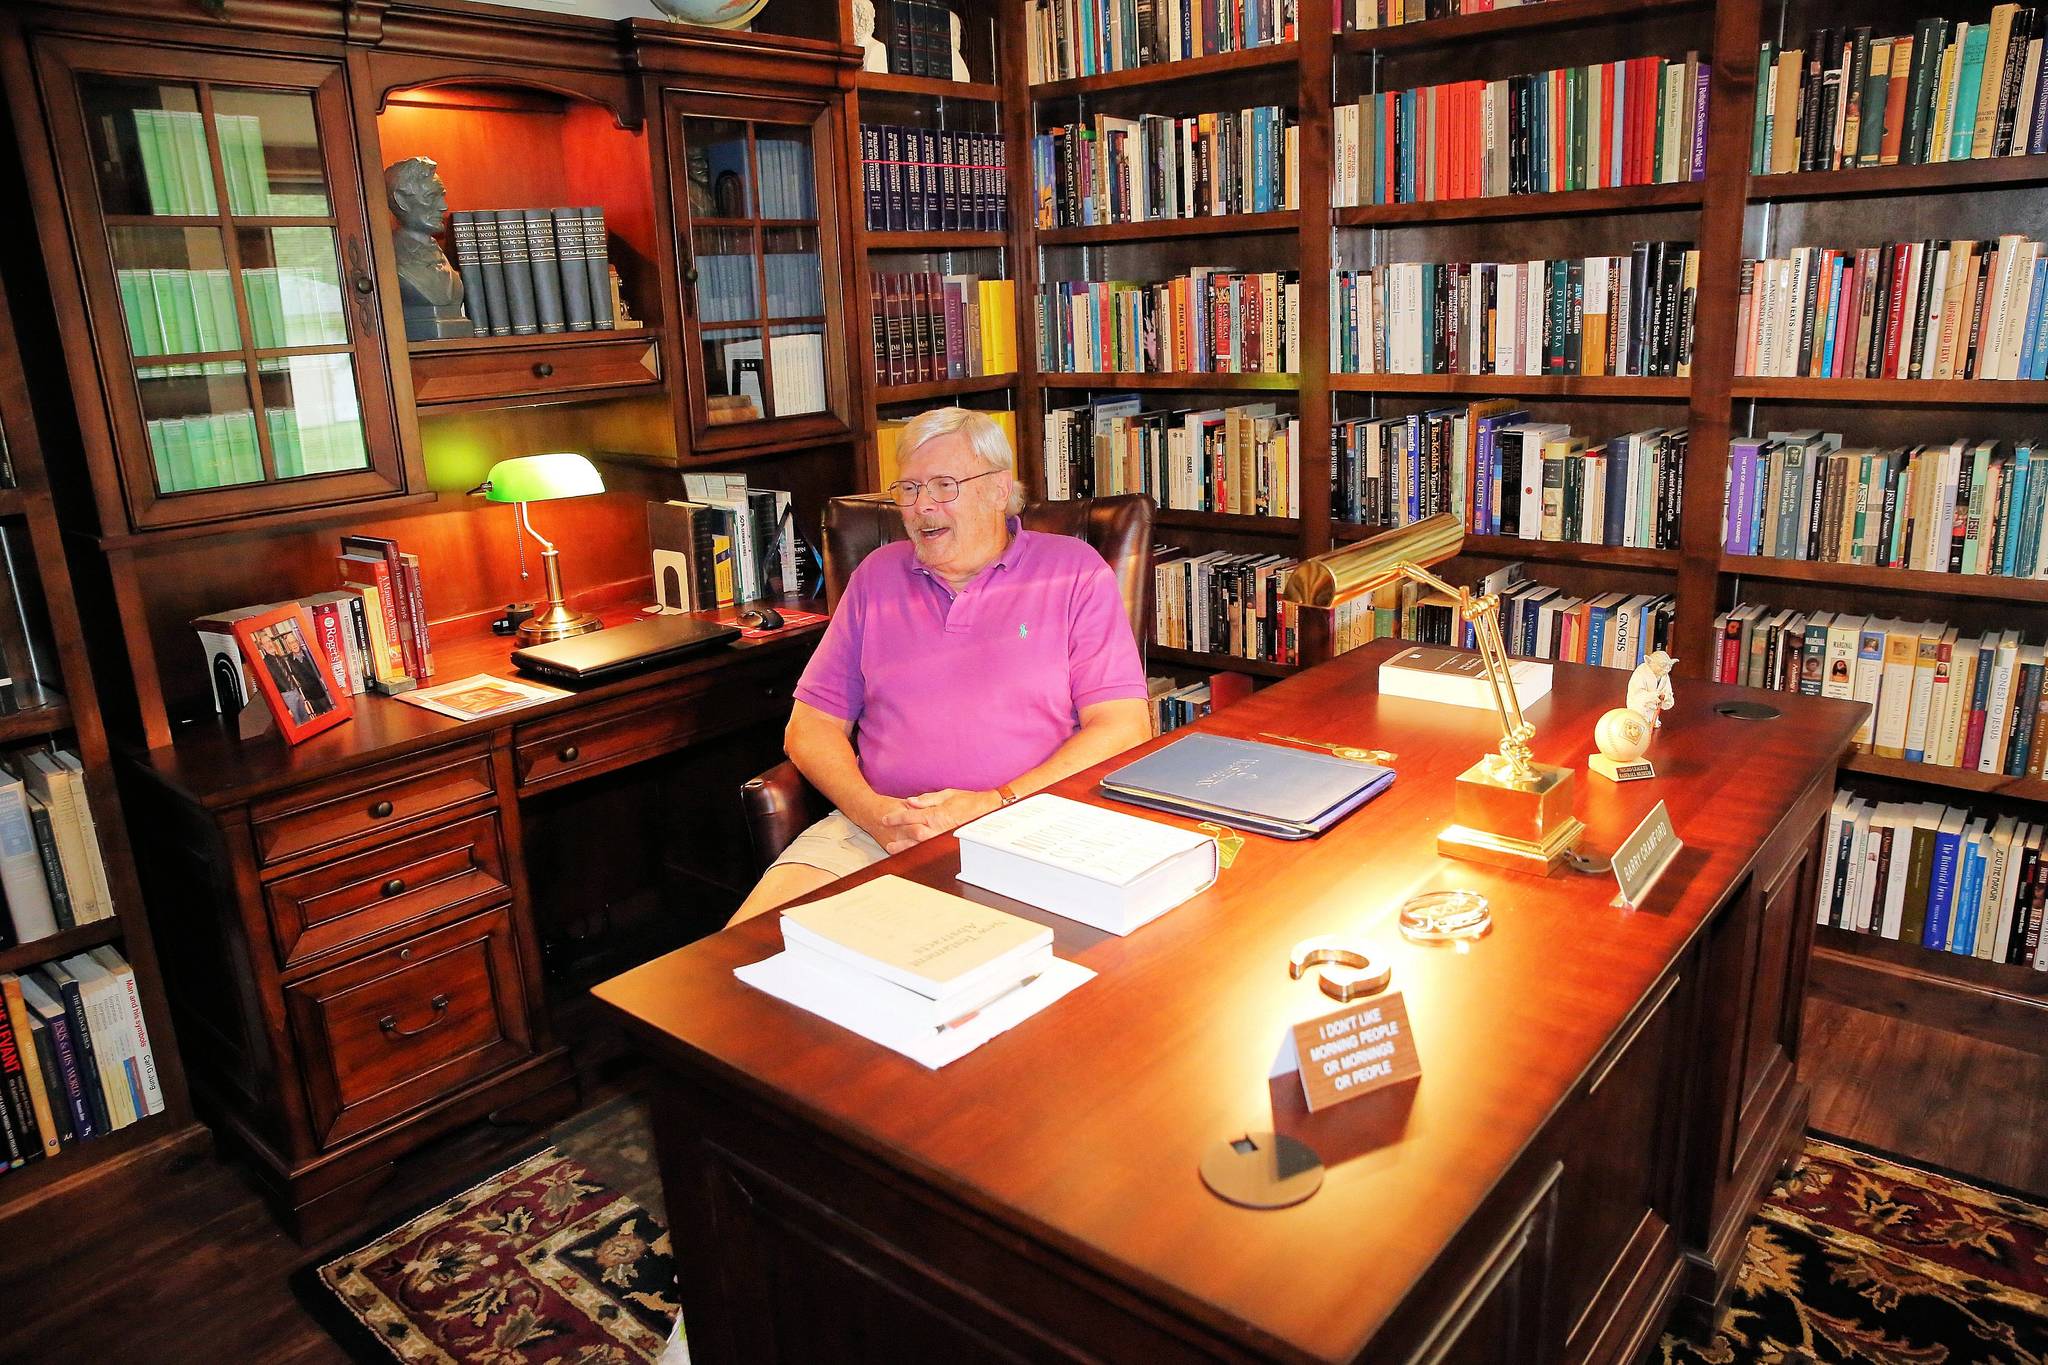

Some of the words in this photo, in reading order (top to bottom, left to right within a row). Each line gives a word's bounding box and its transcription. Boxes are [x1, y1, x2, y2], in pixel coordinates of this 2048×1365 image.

[1792, 257, 1801, 294] MEANING
[1791, 295, 1798, 303] IN
[1976, 281, 1984, 304] MAKING
[1555, 290, 1563, 348] DIASPORA
[1789, 306, 1797, 327] TEXTS
[1940, 345, 1951, 363] TEXTS
[1407, 417, 1416, 451] Masada
[1431, 427, 1439, 472] Bar-Kokhba
[1420, 473, 1425, 481] TO
[1477, 460, 1485, 478] THE
[1430, 472, 1438, 496] Yigael
[1783, 471, 1792, 497] Historical
[1430, 496, 1438, 515] Yadin
[1781, 498, 1789, 515] Jesus
[1885, 488, 1896, 511] JESUS
[1967, 517, 1979, 540] JESUS
[383, 582, 394, 608] Manual
[389, 618, 398, 642] Writers
[1616, 612, 1629, 652] GNOSIS
[325, 627, 339, 661] Roget's
[1591, 635, 1599, 658] gnostic
[1997, 667, 2009, 701] HONEST
[1994, 704, 2003, 714] TO
[1990, 716, 2001, 740] JESUS
[1624, 852, 1642, 882] BARRY
[1640, 821, 1667, 860] CRAWFORD
[1941, 844, 1952, 854] The
[1937, 855, 1950, 885] Historical
[125, 979, 135, 995] Man
[129, 996, 138, 1009] and
[132, 1009, 141, 1019] his
[134, 1019, 147, 1048] symbols
[1320, 1026, 1326, 1040] I
[1326, 1015, 1358, 1038] DON'T
[1359, 1008, 1382, 1027] LIKE
[1310, 1035, 1359, 1062] MORNING
[1359, 1021, 1399, 1044] PEOPLE
[143, 1054, 152, 1069] Carl
[1323, 1060, 1341, 1076] OR
[1341, 1041, 1395, 1069] MORNINGS
[147, 1075, 157, 1091] Jung
[1334, 1074, 1352, 1091] OR
[1353, 1060, 1392, 1084] PEOPLE
